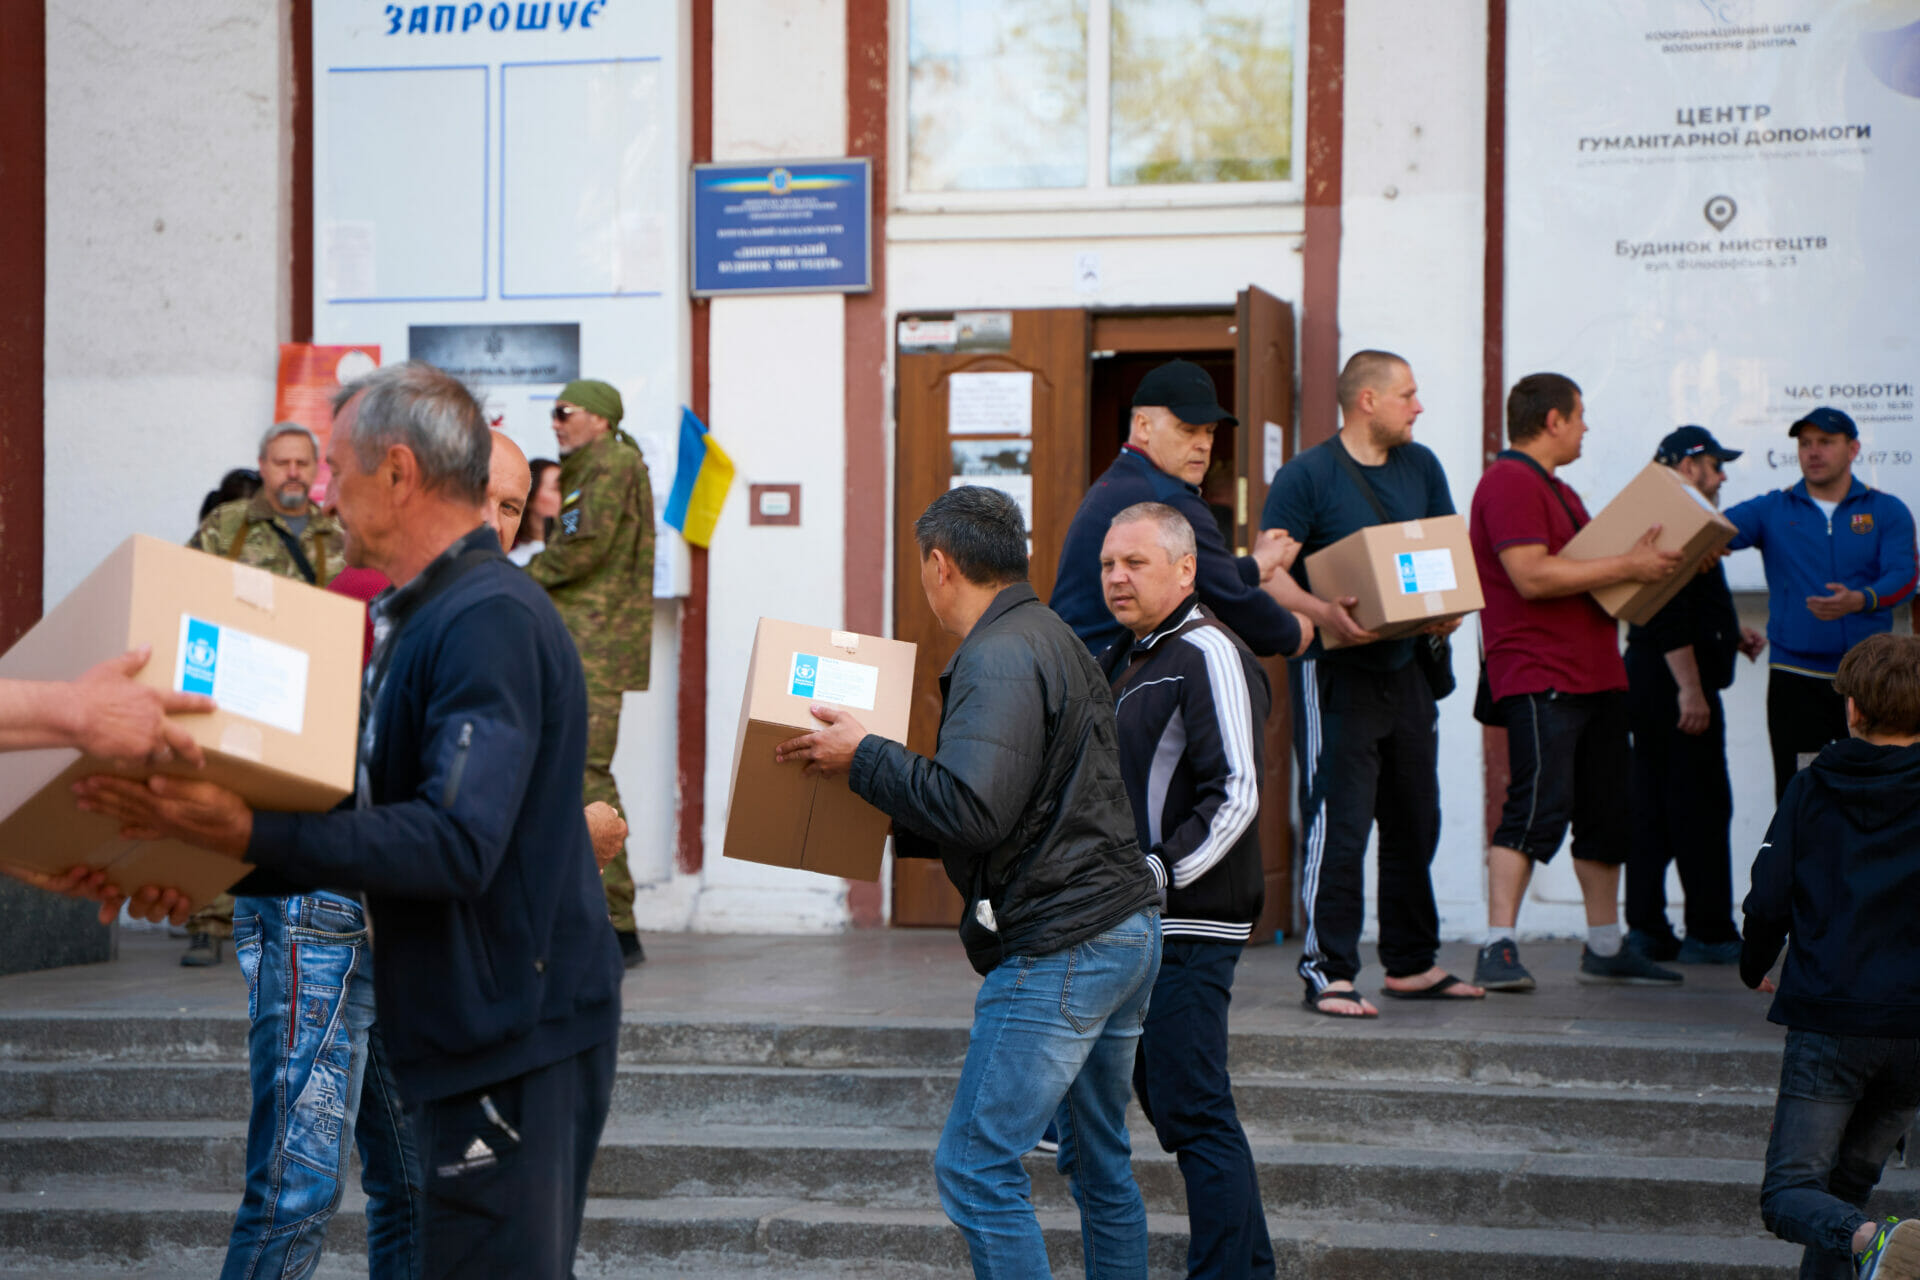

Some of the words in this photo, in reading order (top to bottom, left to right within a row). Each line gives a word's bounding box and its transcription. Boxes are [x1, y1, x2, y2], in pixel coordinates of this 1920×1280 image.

[385, 0, 606, 35] ЗАПРОШУЄ
[1676, 104, 1771, 127] ЦЕНТР
[1578, 128, 1739, 152] ГУМАНІТАРНОЇ
[1745, 124, 1872, 146] ДОПОМОГИ
[1615, 239, 1712, 259] Будинок
[1719, 236, 1828, 252] мистецтв
[1785, 384, 1824, 399] ЧАС
